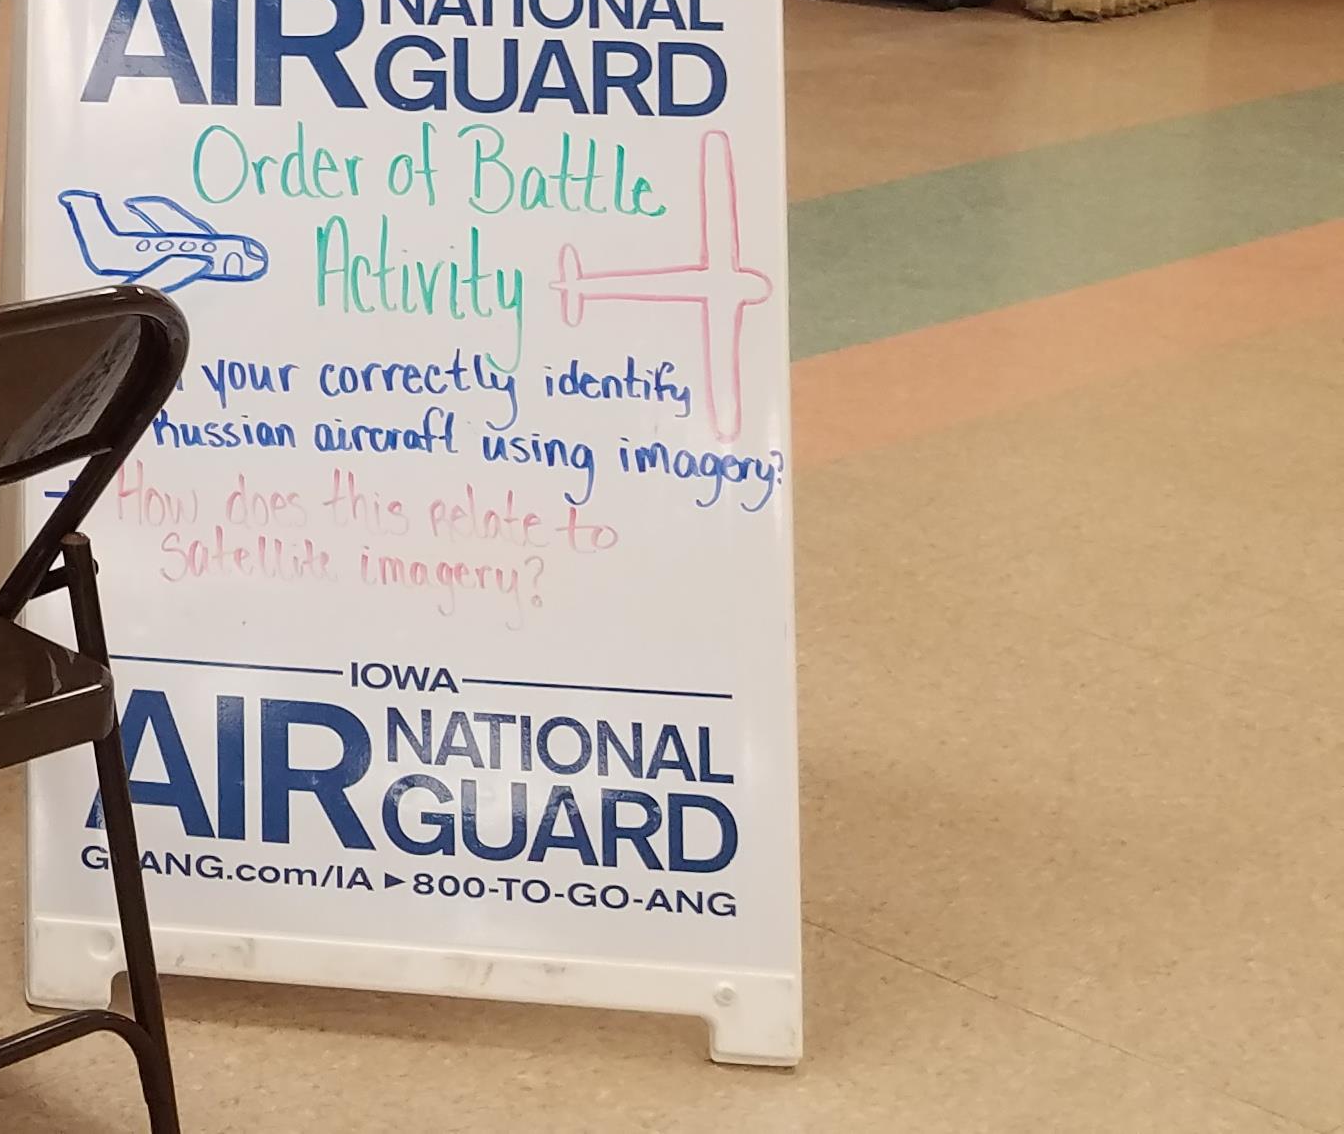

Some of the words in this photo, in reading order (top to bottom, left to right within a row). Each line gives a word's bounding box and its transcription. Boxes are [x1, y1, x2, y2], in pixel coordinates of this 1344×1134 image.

[373, 34, 728, 118] GUARD
[193, 121, 363, 204] Order
[387, 121, 438, 206] of
[458, 123, 666, 216] Battle
[315, 213, 526, 374] Activity
[201, 358, 301, 409] your
[319, 348, 518, 429] correctly
[544, 355, 691, 417] identify
[152, 408, 297, 448] Russian
[313, 406, 459, 455] aircraft
[482, 428, 595, 505] using
[619, 437, 785, 513] imagery?
[116, 460, 199, 527] How
[225, 472, 308, 528] does
[323, 467, 410, 537] this
[429, 483, 551, 549] relate
[555, 506, 620, 554] to
[360, 543, 546, 631] imagery?
[350, 662, 459, 694] IOWA
[85, 688, 377, 851] AIR
[387, 706, 734, 785] NATIONAL
[381, 773, 739, 874] GUARD
[81, 845, 374, 892] GANG.com/IA
[412, 873, 738, 918] 800-TO-GO-ANG
